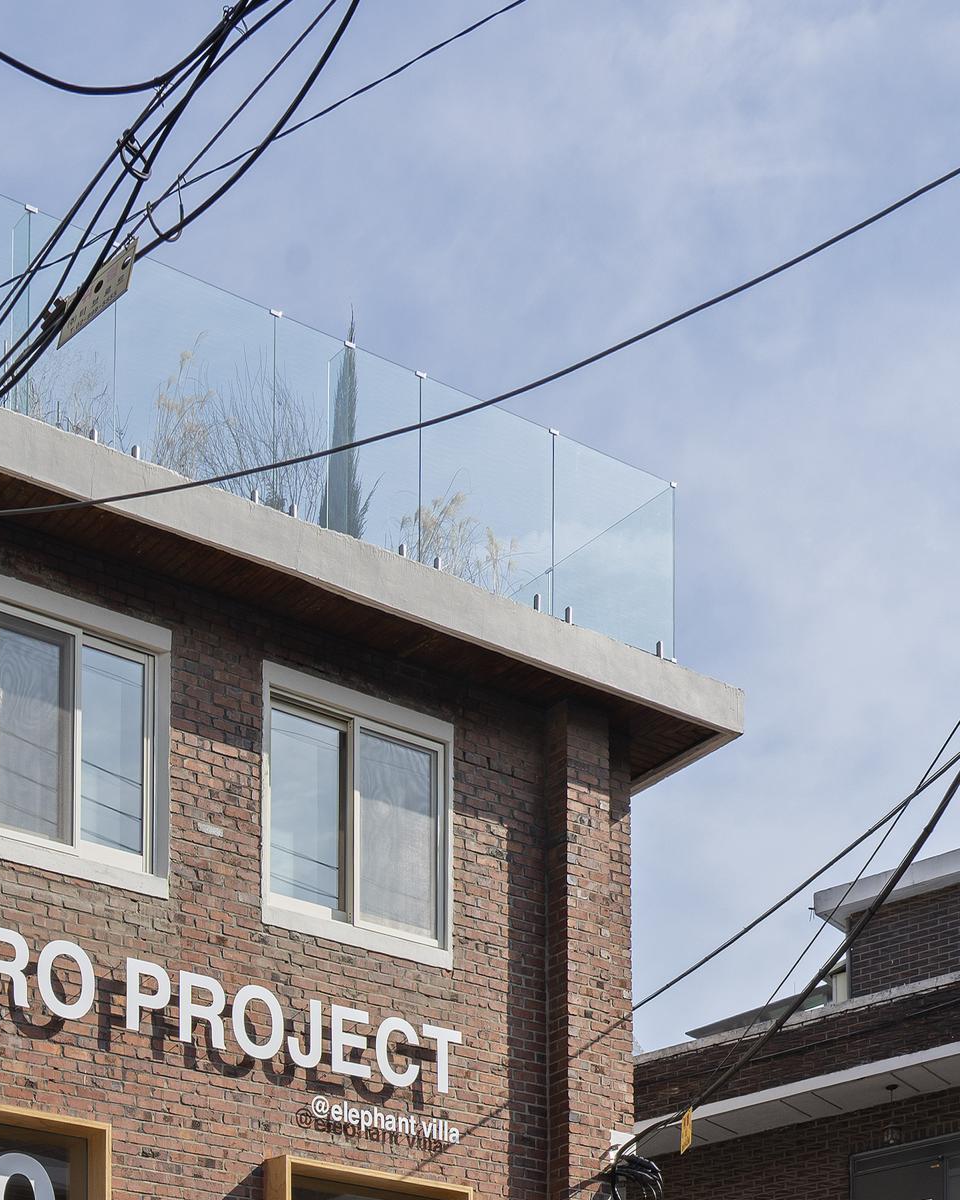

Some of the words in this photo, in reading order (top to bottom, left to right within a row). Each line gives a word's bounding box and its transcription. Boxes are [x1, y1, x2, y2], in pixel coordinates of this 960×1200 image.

[126, 957, 462, 1093] PROJECT
[311, 1095, 417, 1136] @elephant
[421, 1117, 460, 1144] villa
